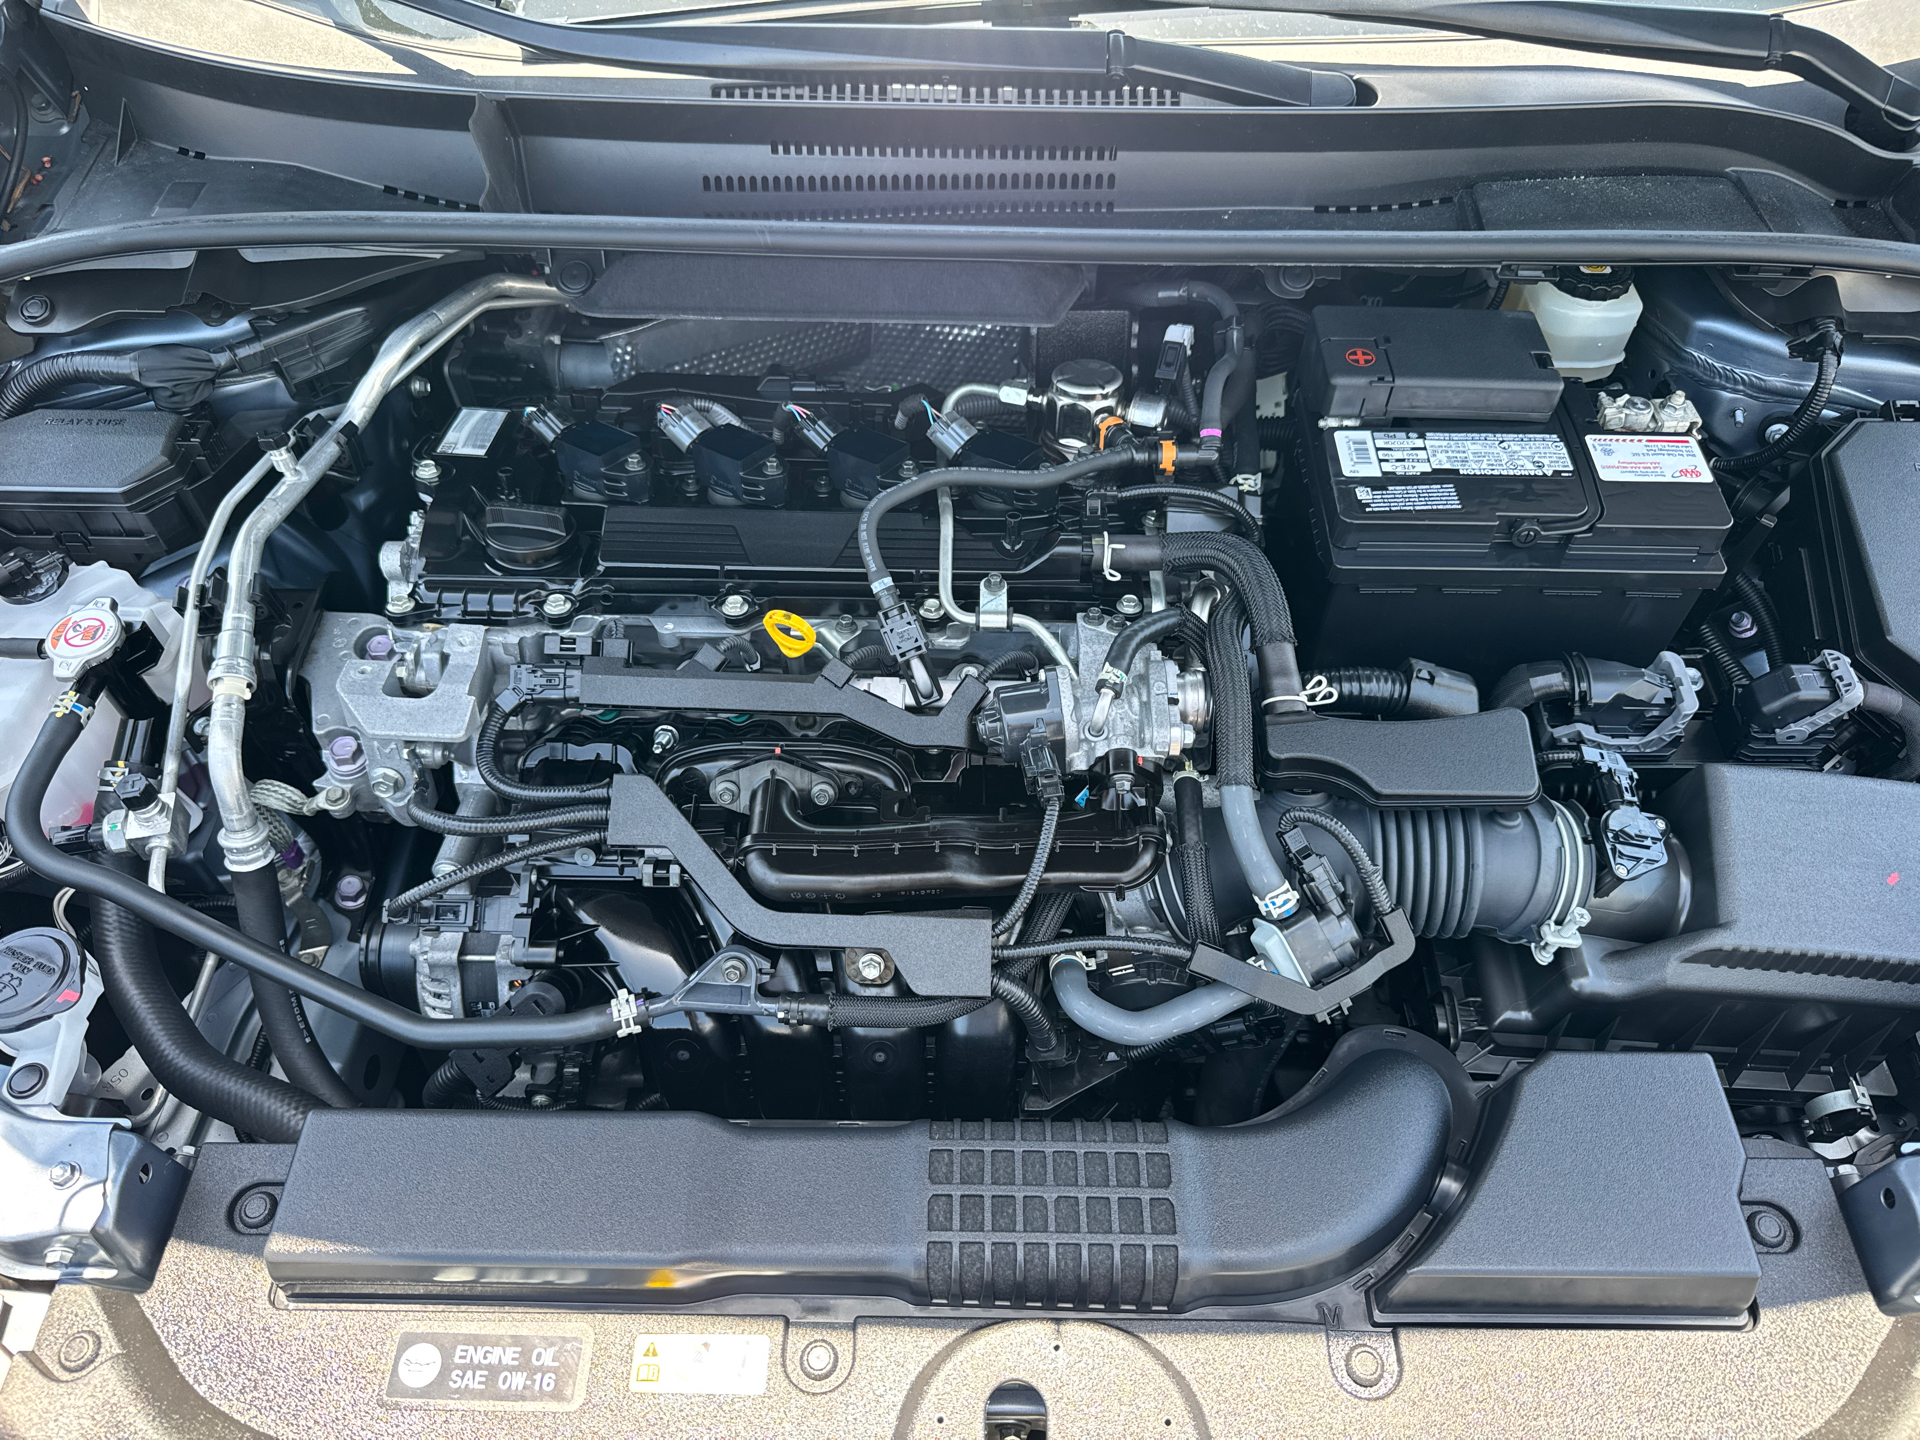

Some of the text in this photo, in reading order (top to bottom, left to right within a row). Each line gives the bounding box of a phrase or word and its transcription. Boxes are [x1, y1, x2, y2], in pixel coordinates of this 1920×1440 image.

[1679, 468, 1701, 478] AAA
[454, 1345, 560, 1366] ENGINE OIL
[449, 1370, 556, 1392] SAE 0W-16
